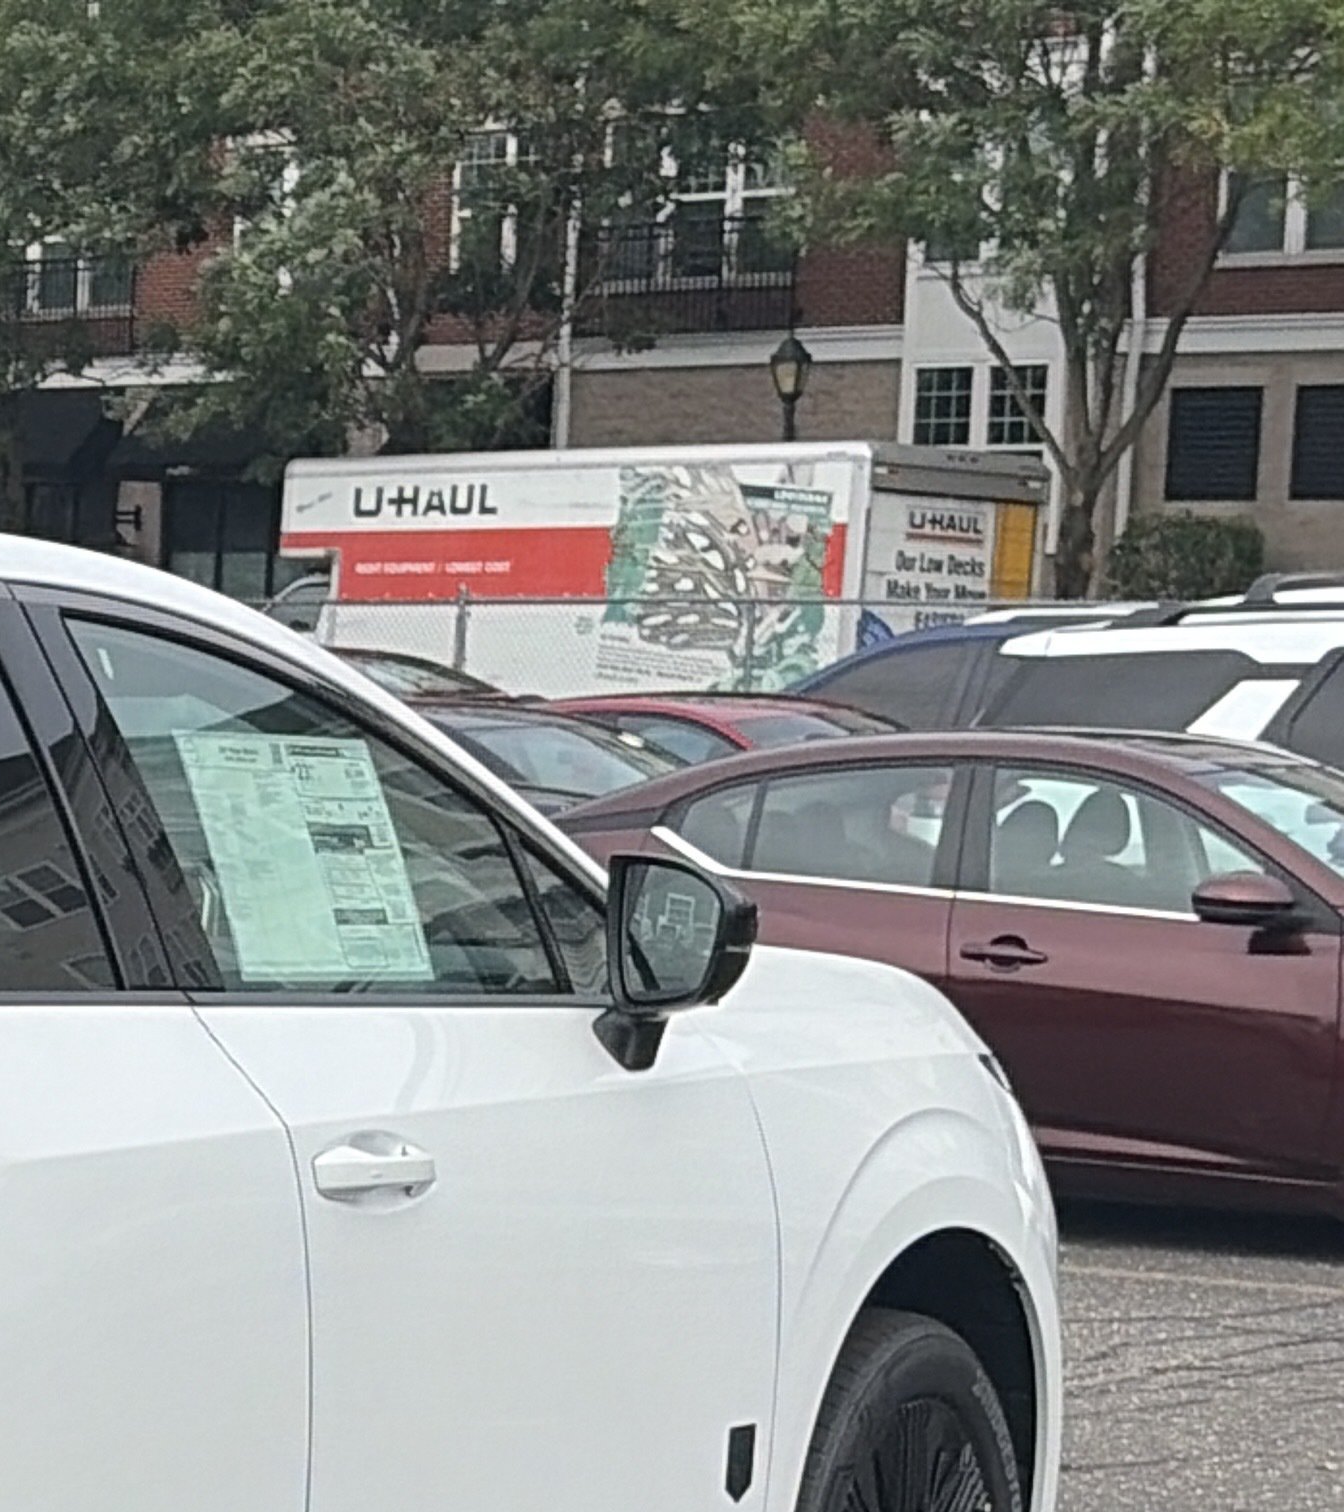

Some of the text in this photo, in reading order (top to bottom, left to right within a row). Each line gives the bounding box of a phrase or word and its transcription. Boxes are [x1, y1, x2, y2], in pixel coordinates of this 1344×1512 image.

[353, 484, 498, 517] U-HAUL
[909, 510, 983, 535] U-HAUL
[895, 550, 985, 578] Our Low Decks
[886, 578, 920, 599] Make
